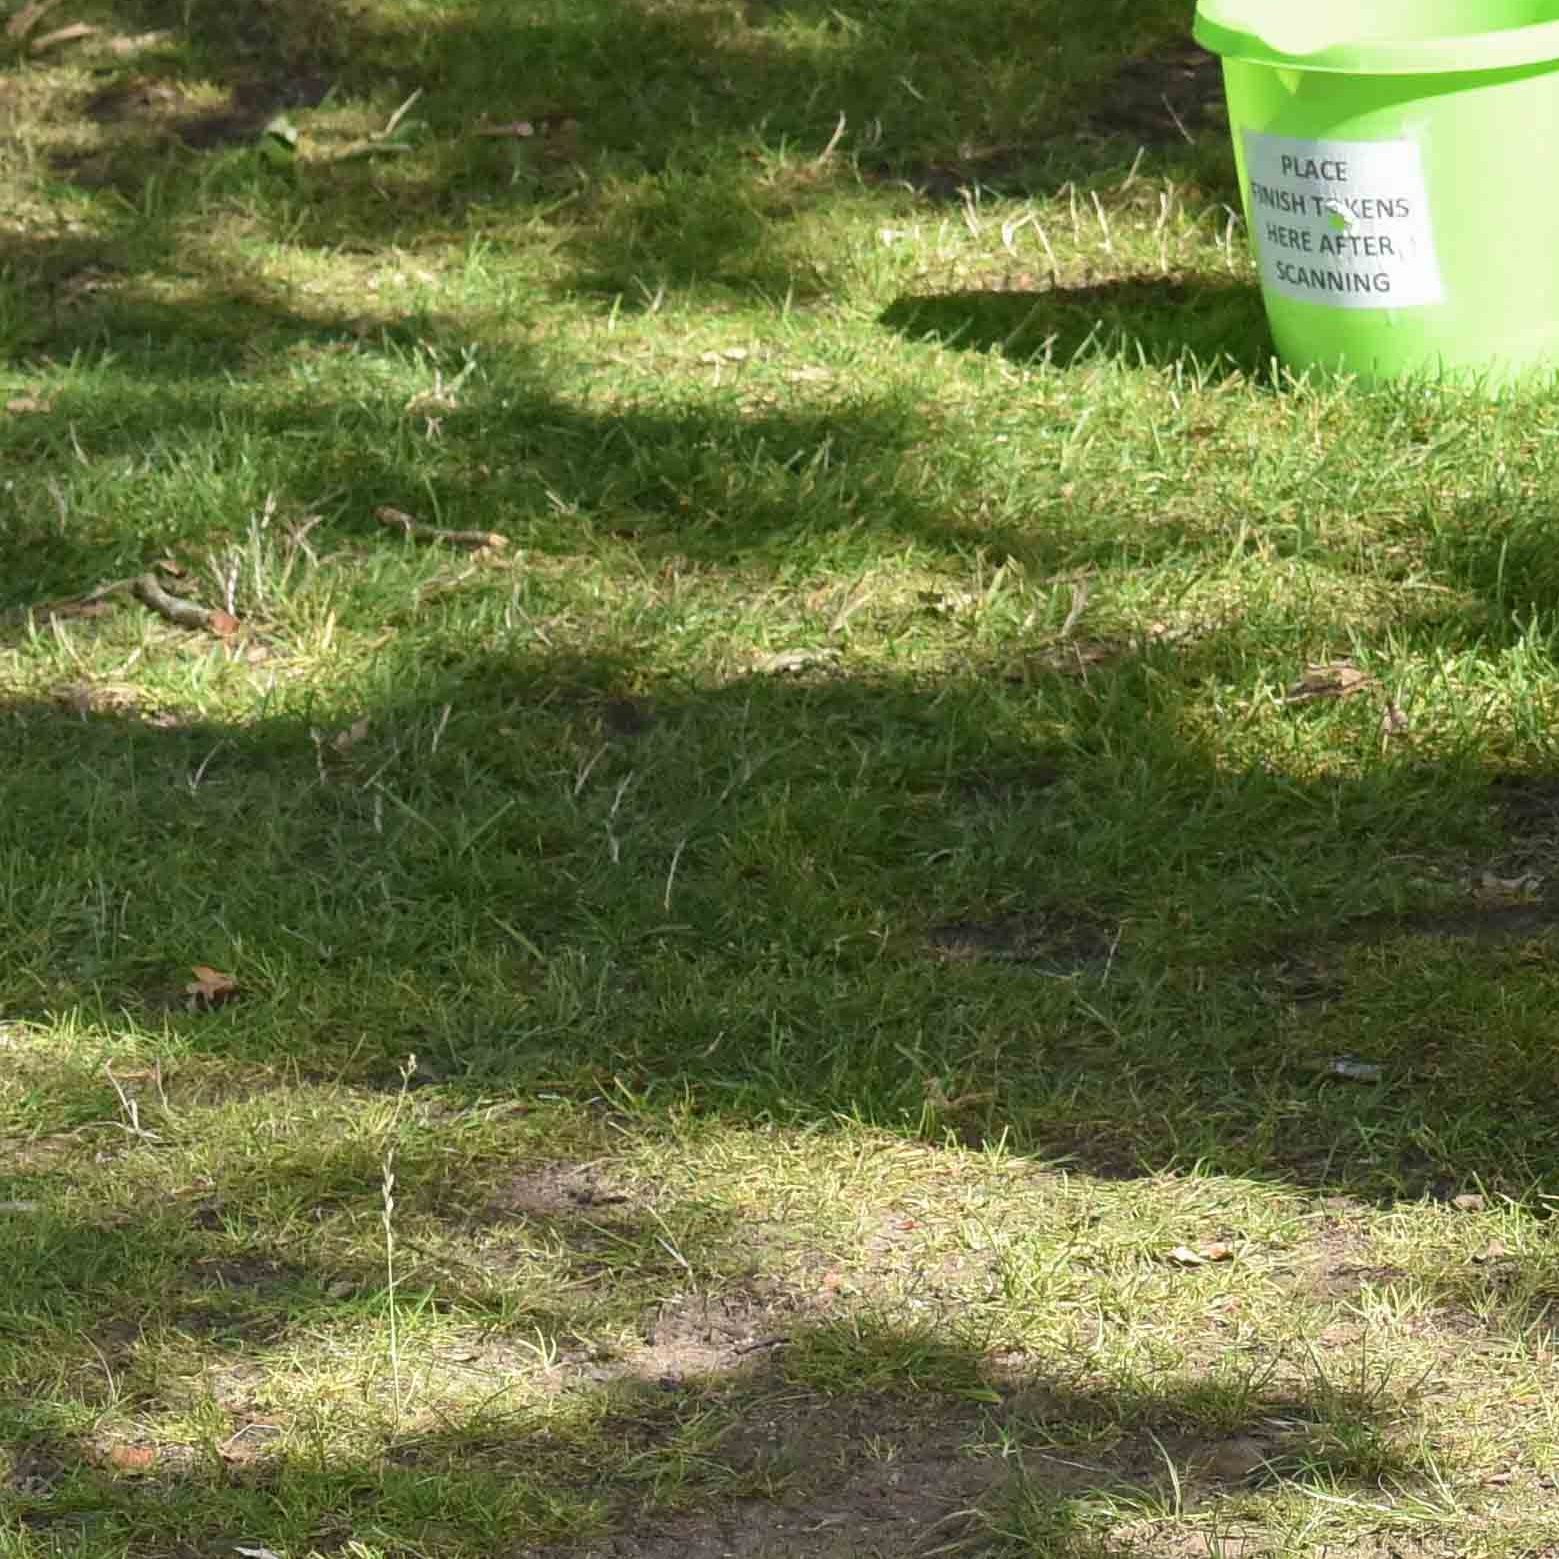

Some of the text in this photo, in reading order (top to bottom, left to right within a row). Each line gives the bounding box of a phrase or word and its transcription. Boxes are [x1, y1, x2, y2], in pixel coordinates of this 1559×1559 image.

[1281, 154, 1348, 182] PLACE
[1251, 182, 1410, 220] FINISH TKENS
[1267, 222, 1395, 257] HERE AFTER
[1275, 260, 1391, 293] SCANNING
